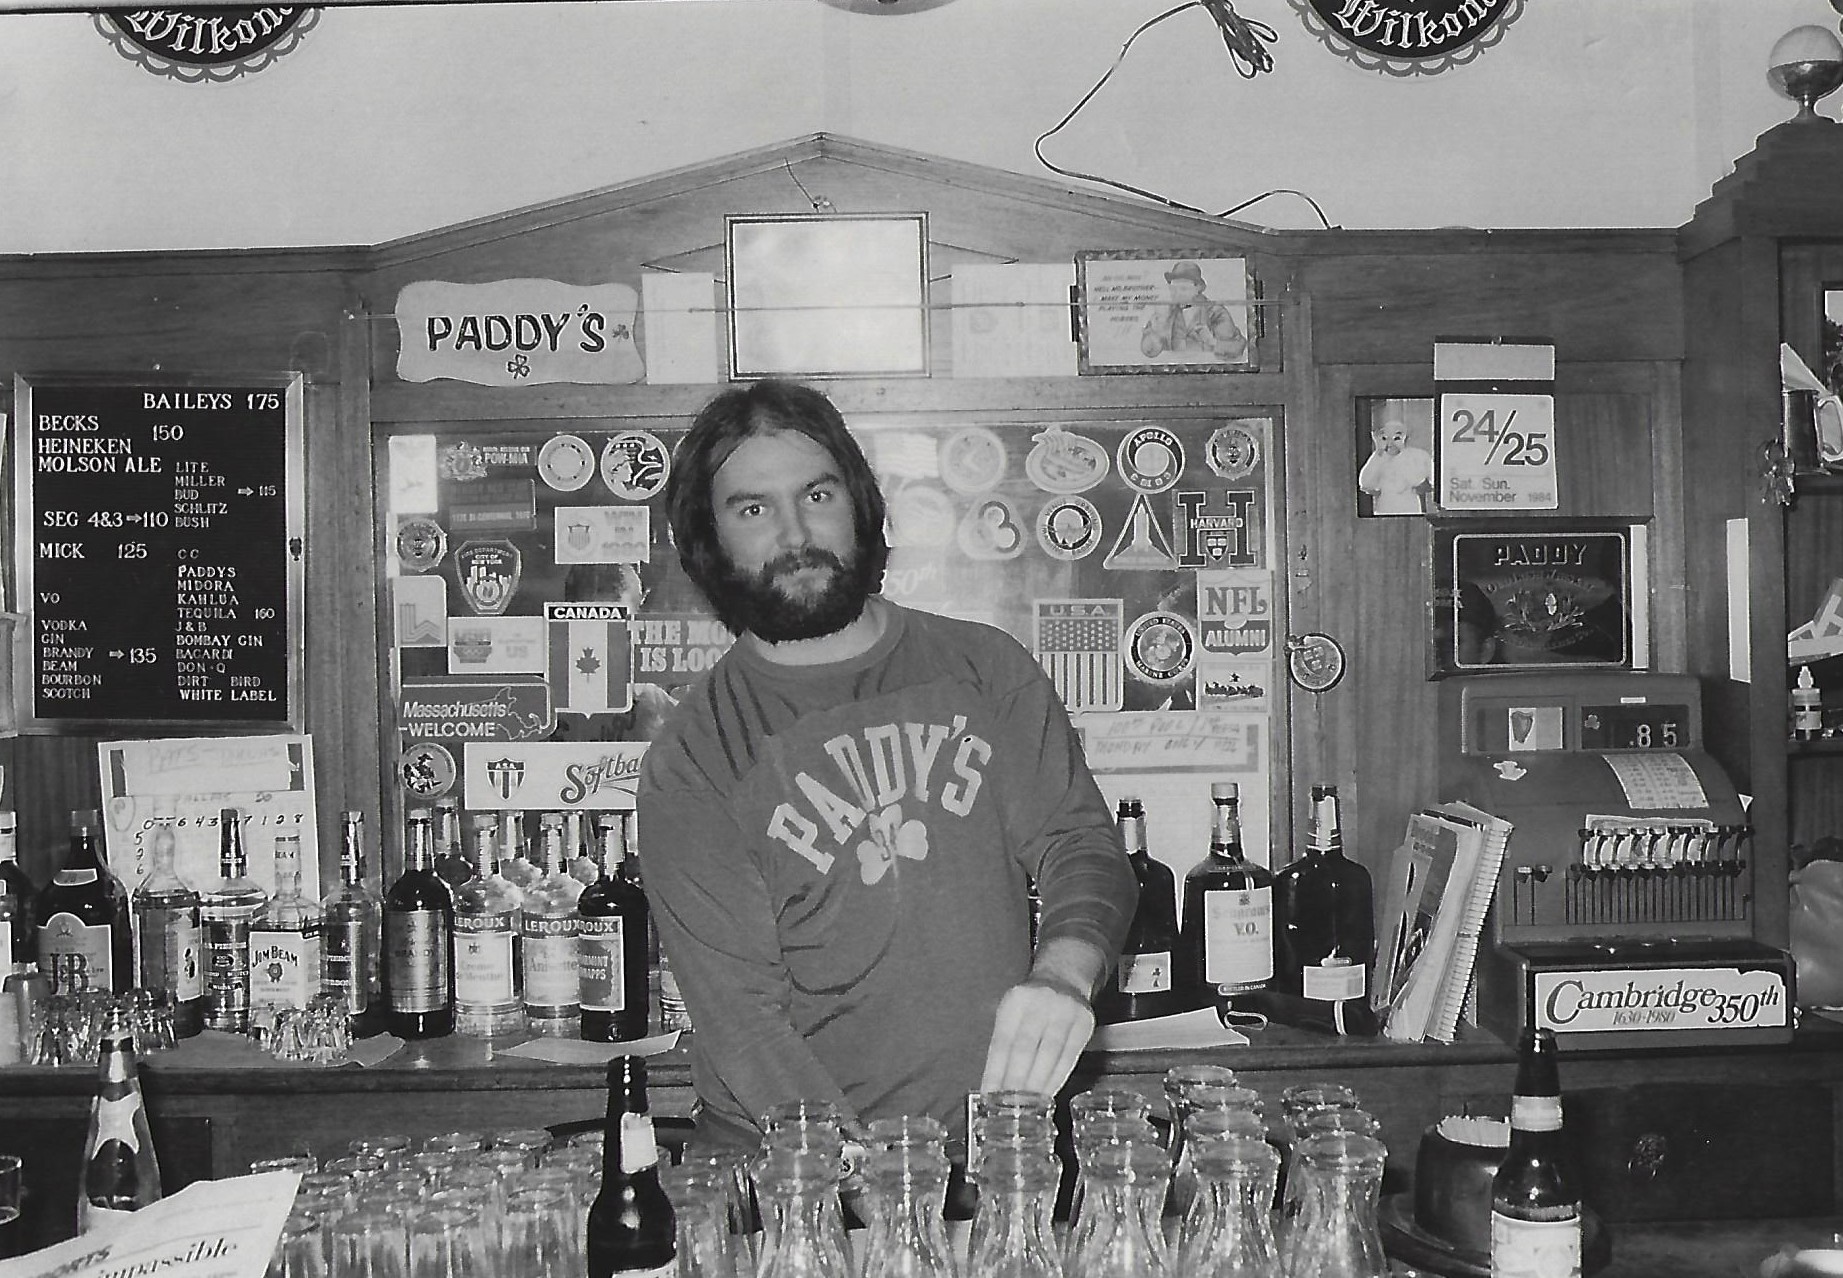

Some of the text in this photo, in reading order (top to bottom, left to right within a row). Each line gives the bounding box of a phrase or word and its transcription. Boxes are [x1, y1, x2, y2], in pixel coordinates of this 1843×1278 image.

[426, 303, 606, 354] PADDY'S
[144, 393, 279, 409] BAILEYS 175
[40, 415, 99, 431] BECKS
[153, 425, 183, 441] 150
[38, 438, 131, 454] HEINEKEN
[39, 456, 161, 472] MOLSON ALE
[176, 462, 208, 473] LITE
[175, 476, 225, 486] MILLER
[175, 486, 276, 501] BUD 115
[1450, 490, 1517, 502] November
[175, 503, 227, 514] SCHLITZ
[44, 511, 168, 527] SEG 4&3 110
[1190, 517, 1243, 529] HARVARD
[40, 543, 147, 558] MICK 125
[1494, 544, 1587, 566] PADDY
[179, 565, 235, 577] PADDYS
[178, 580, 234, 591] MIDORA
[40, 593, 59, 603] VO
[178, 594, 238, 605] KAHLUA
[1205, 586, 1267, 616] NFL
[178, 608, 274, 619] TEQUILA 160
[553, 606, 623, 620] CANADA
[41, 620, 87, 630] VODKA
[42, 633, 64, 644] GIN
[628, 620, 681, 645] THE
[1205, 629, 1266, 647] ALUMNI
[177, 635, 262, 646] BOMBAY GIN
[44, 647, 156, 663] BRANDY 135
[176, 649, 232, 660] BACARDI
[640, 647, 668, 672] IS
[43, 661, 77, 671] BEAM
[42, 674, 101, 685] BOURBON
[178, 676, 260, 687] DIRT BIRD
[180, 689, 276, 701] WHITE LABEL
[403, 701, 506, 719] Massachusetts
[408, 723, 496, 737] WELCOME
[560, 752, 642, 804] Softba
[766, 714, 992, 875] PADDY'S
[454, 916, 504, 930] LEROUX
[526, 919, 579, 932] LEROUX
[578, 921, 614, 933] ROUX
[252, 949, 270, 968] JIM
[271, 945, 298, 967] BEAM
[1546, 979, 1781, 1026] Cambridge 350th
[1612, 1008, 1677, 1026] 1630-1980
